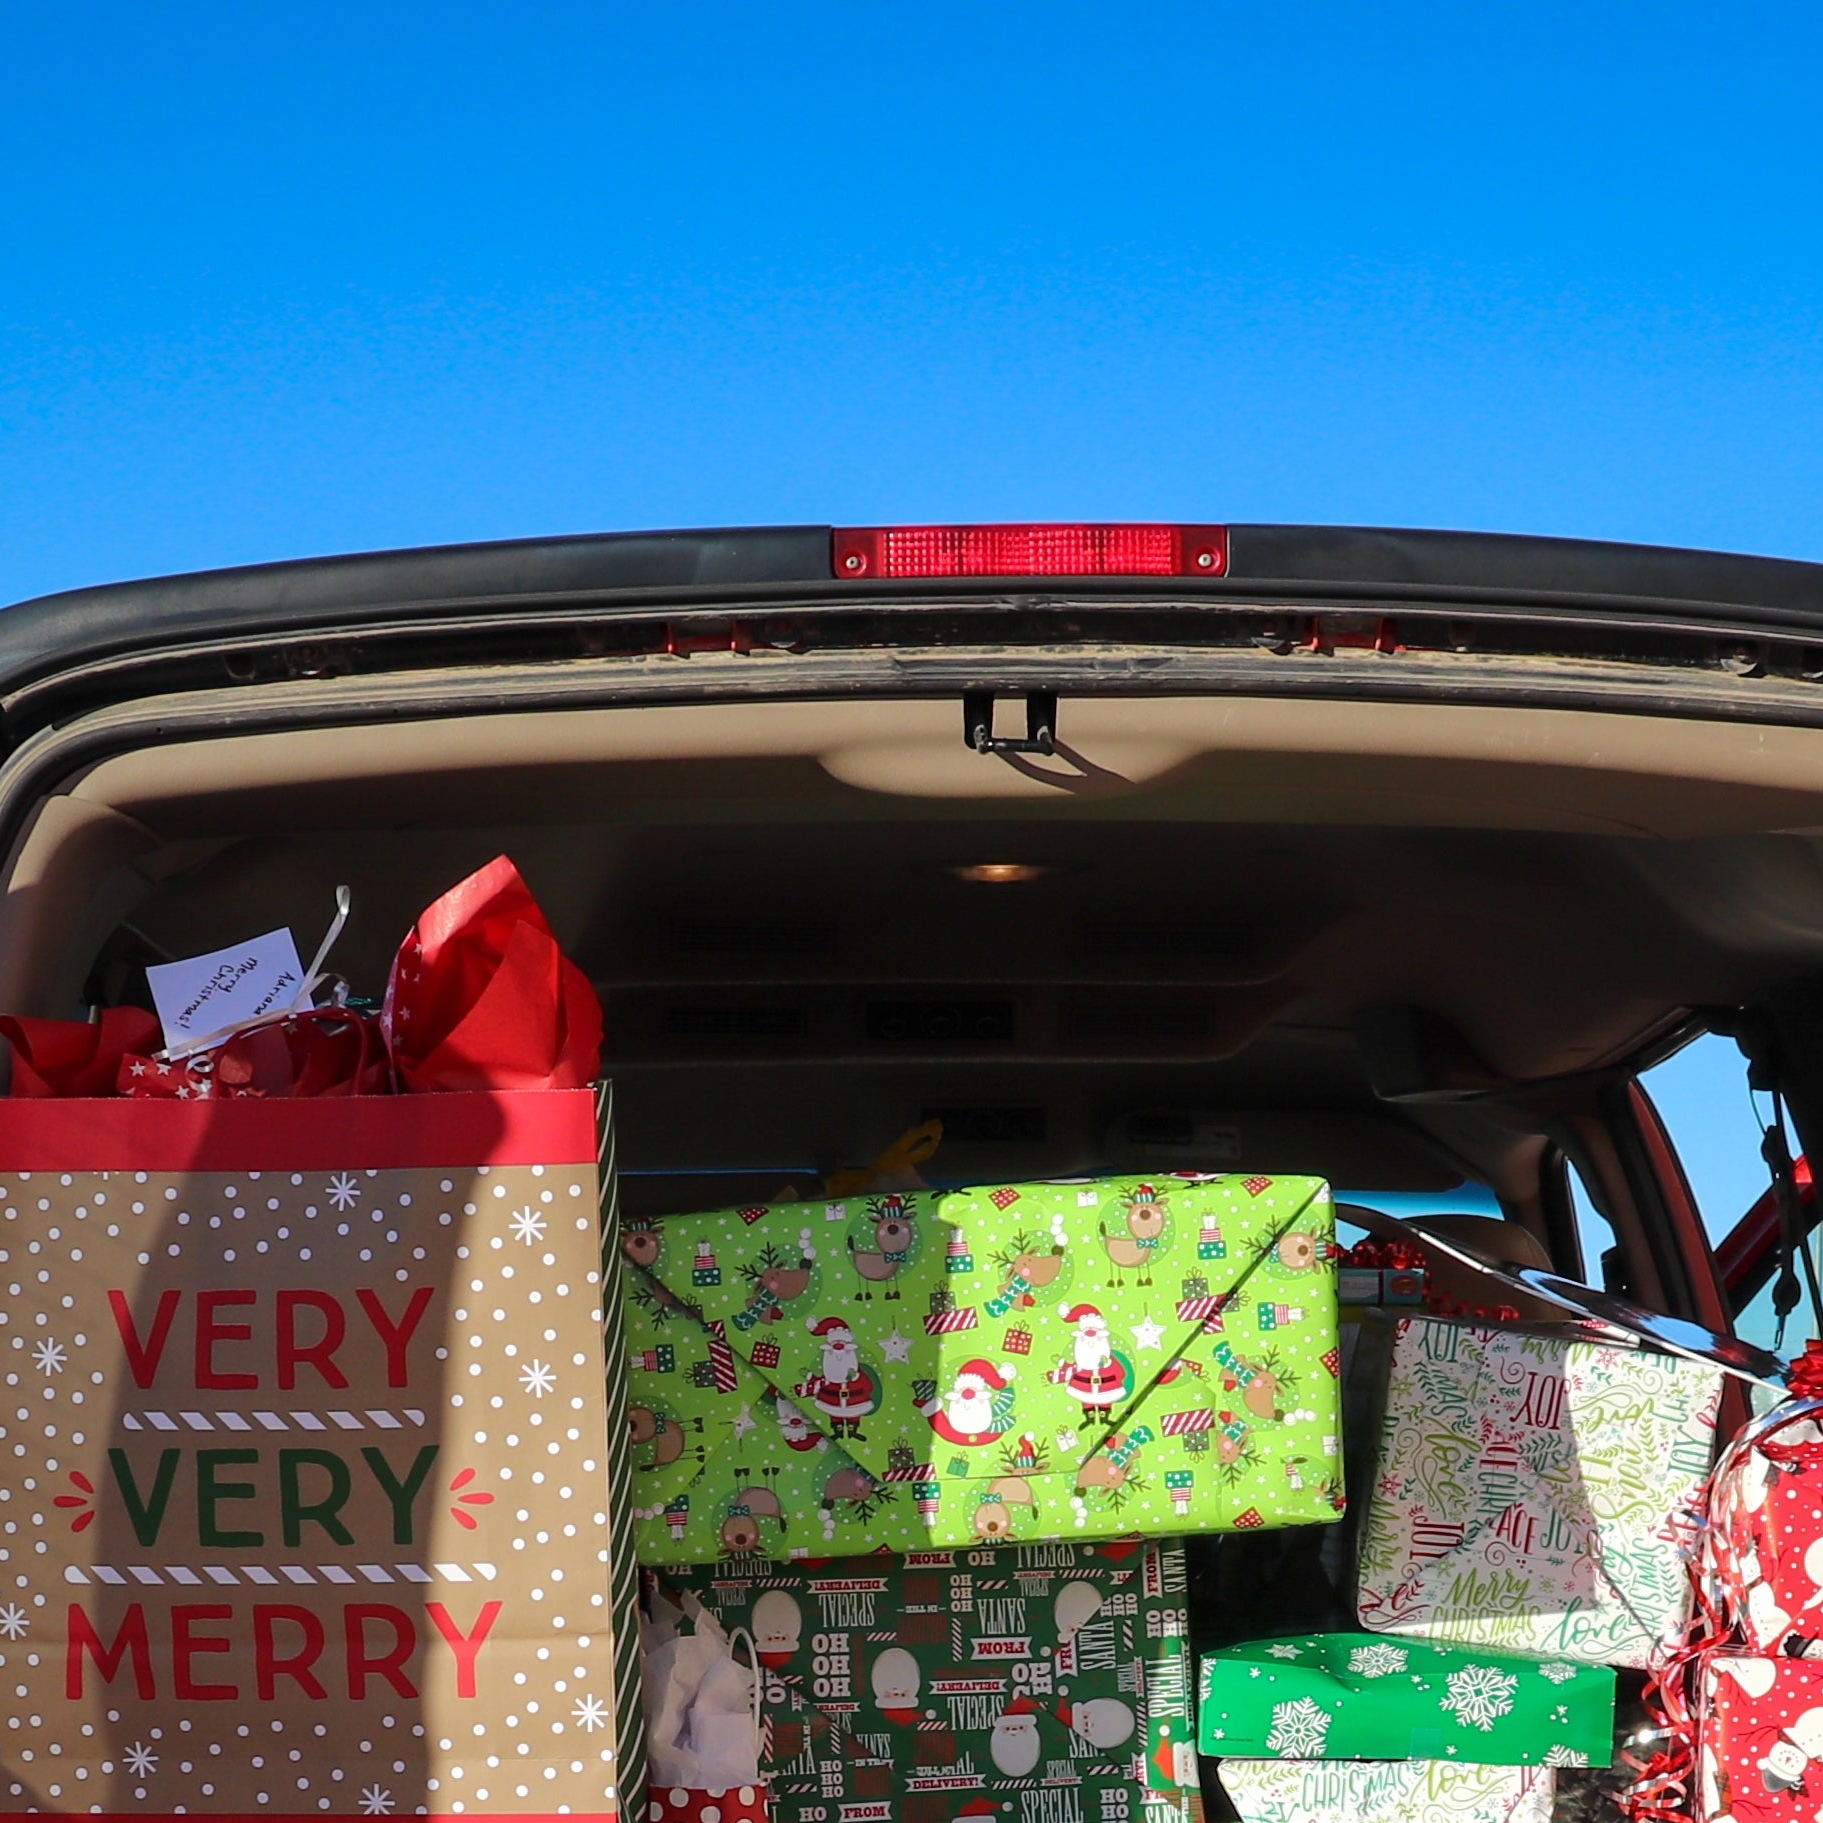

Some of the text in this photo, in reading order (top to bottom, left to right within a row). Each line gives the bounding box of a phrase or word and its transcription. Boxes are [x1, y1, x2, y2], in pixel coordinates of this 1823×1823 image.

[217, 957, 258, 993] Merry
[107, 1286, 435, 1390] VERY
[1509, 1371, 1572, 1430] JOY
[108, 1445, 440, 1548] VERY
[909, 1553, 951, 1565] FROM
[968, 1552, 996, 1566] HO
[950, 1574, 973, 1587] HO
[1144, 1551, 1158, 1594] FROM
[812, 1579, 882, 1591] DELIVERY!
[950, 1587, 973, 1600] HO
[1441, 1567, 1535, 1610] Merry
[818, 1593, 876, 1628] SPECIAL
[950, 1600, 974, 1613] HO
[1113, 1593, 1125, 1616] HO
[1125, 1592, 1138, 1616] HO
[977, 1598, 1026, 1635] SANTA
[1146, 1610, 1162, 1638] HO
[1540, 1595, 1627, 1650] love
[65, 1600, 503, 1701] MERRY
[811, 1633, 850, 1654] HO
[977, 1640, 1027, 1655] FROM
[812, 1655, 850, 1675] HO
[813, 1677, 851, 1698] HO
[936, 1680, 1000, 1693] DELIVERY!
[1145, 1654, 1184, 1718] SPECIAL
[947, 1695, 1005, 1730] SPECIAL
[820, 1760, 843, 1773] HO
[821, 1773, 844, 1786] HO
[913, 1778, 979, 1790] DELIVERY!
[1411, 1760, 1492, 1802] love
[822, 1786, 845, 1799] HO
[1100, 1788, 1128, 1804] HO
[799, 1807, 827, 1822] HO
[843, 1805, 886, 1819] FROM
[1101, 1804, 1129, 1820] HO
